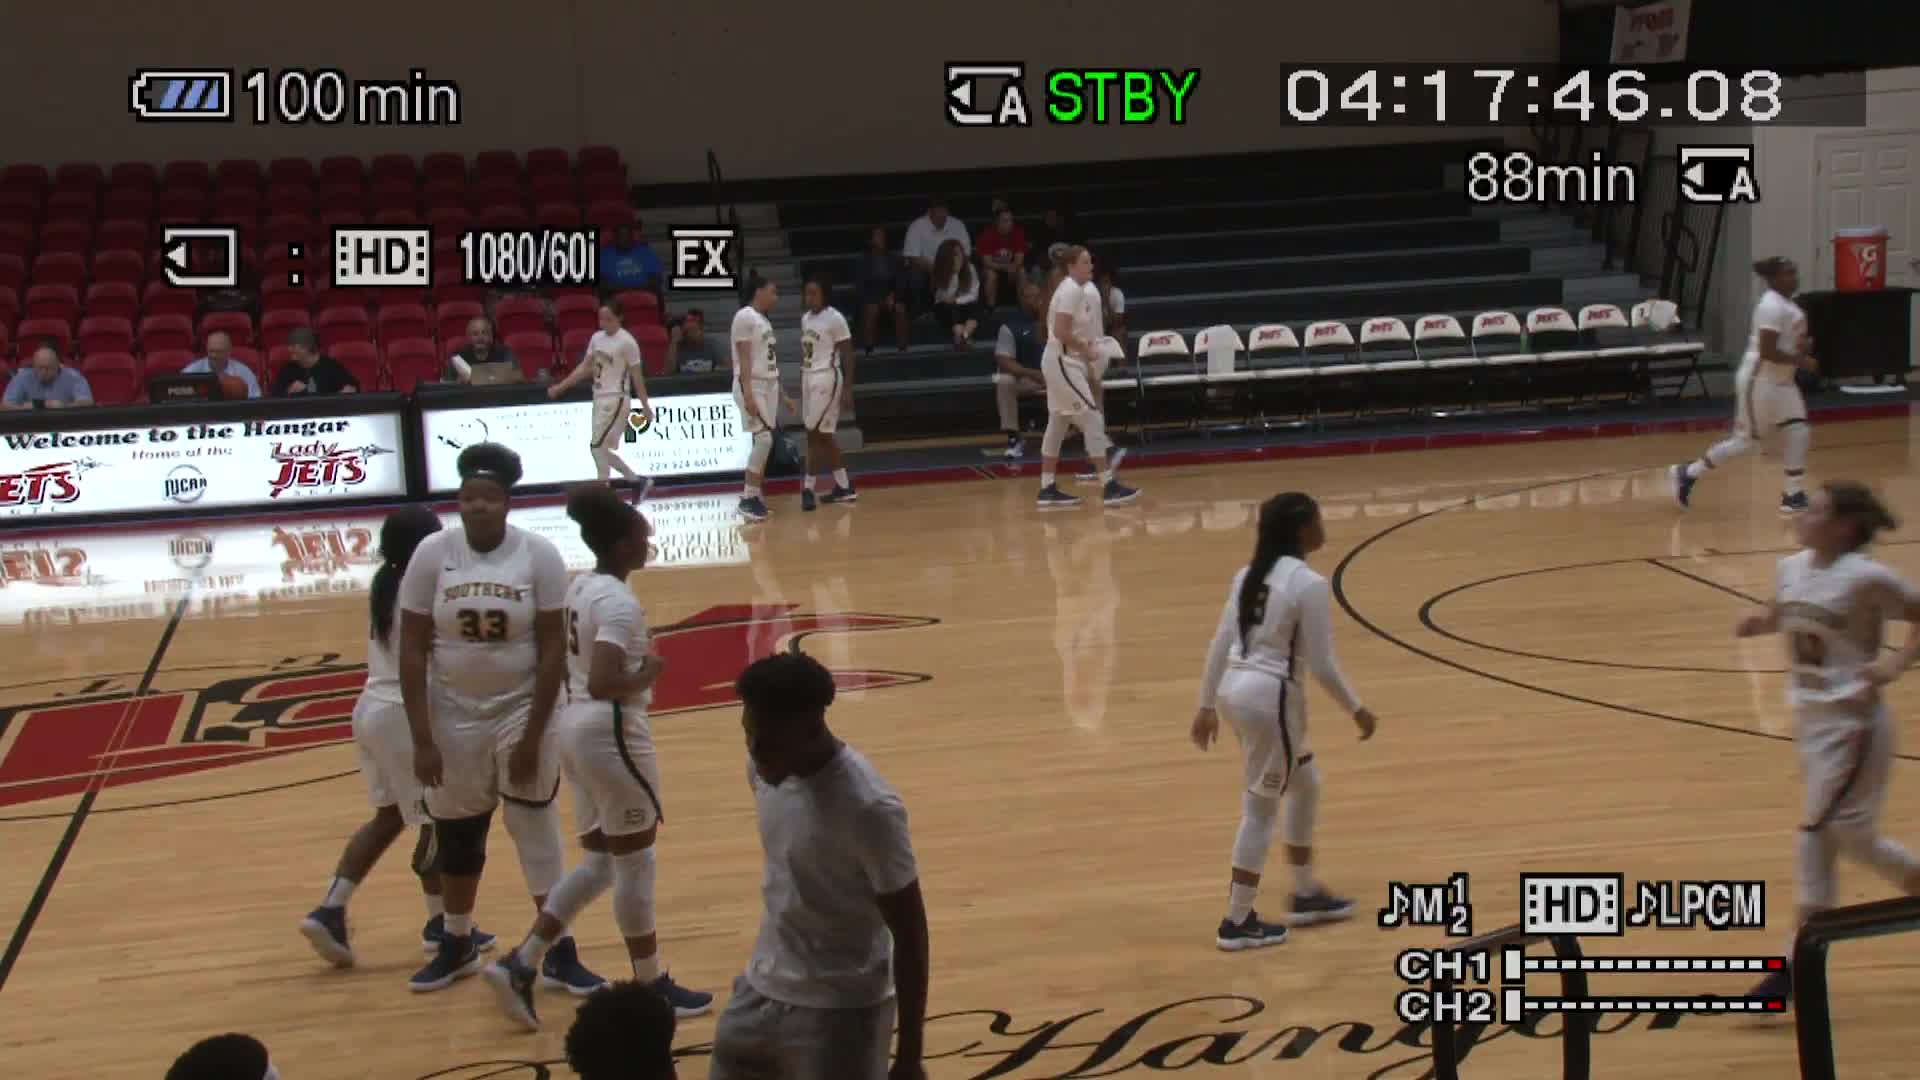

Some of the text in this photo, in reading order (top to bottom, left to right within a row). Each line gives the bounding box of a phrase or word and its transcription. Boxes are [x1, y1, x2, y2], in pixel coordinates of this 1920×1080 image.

[655, 404, 734, 424] PHOEBE
[4, 420, 350, 450] Welcome to the Hangar
[270, 440, 339, 459] Lady
[268, 456, 367, 499] JETS
[456, 608, 509, 642] 33
